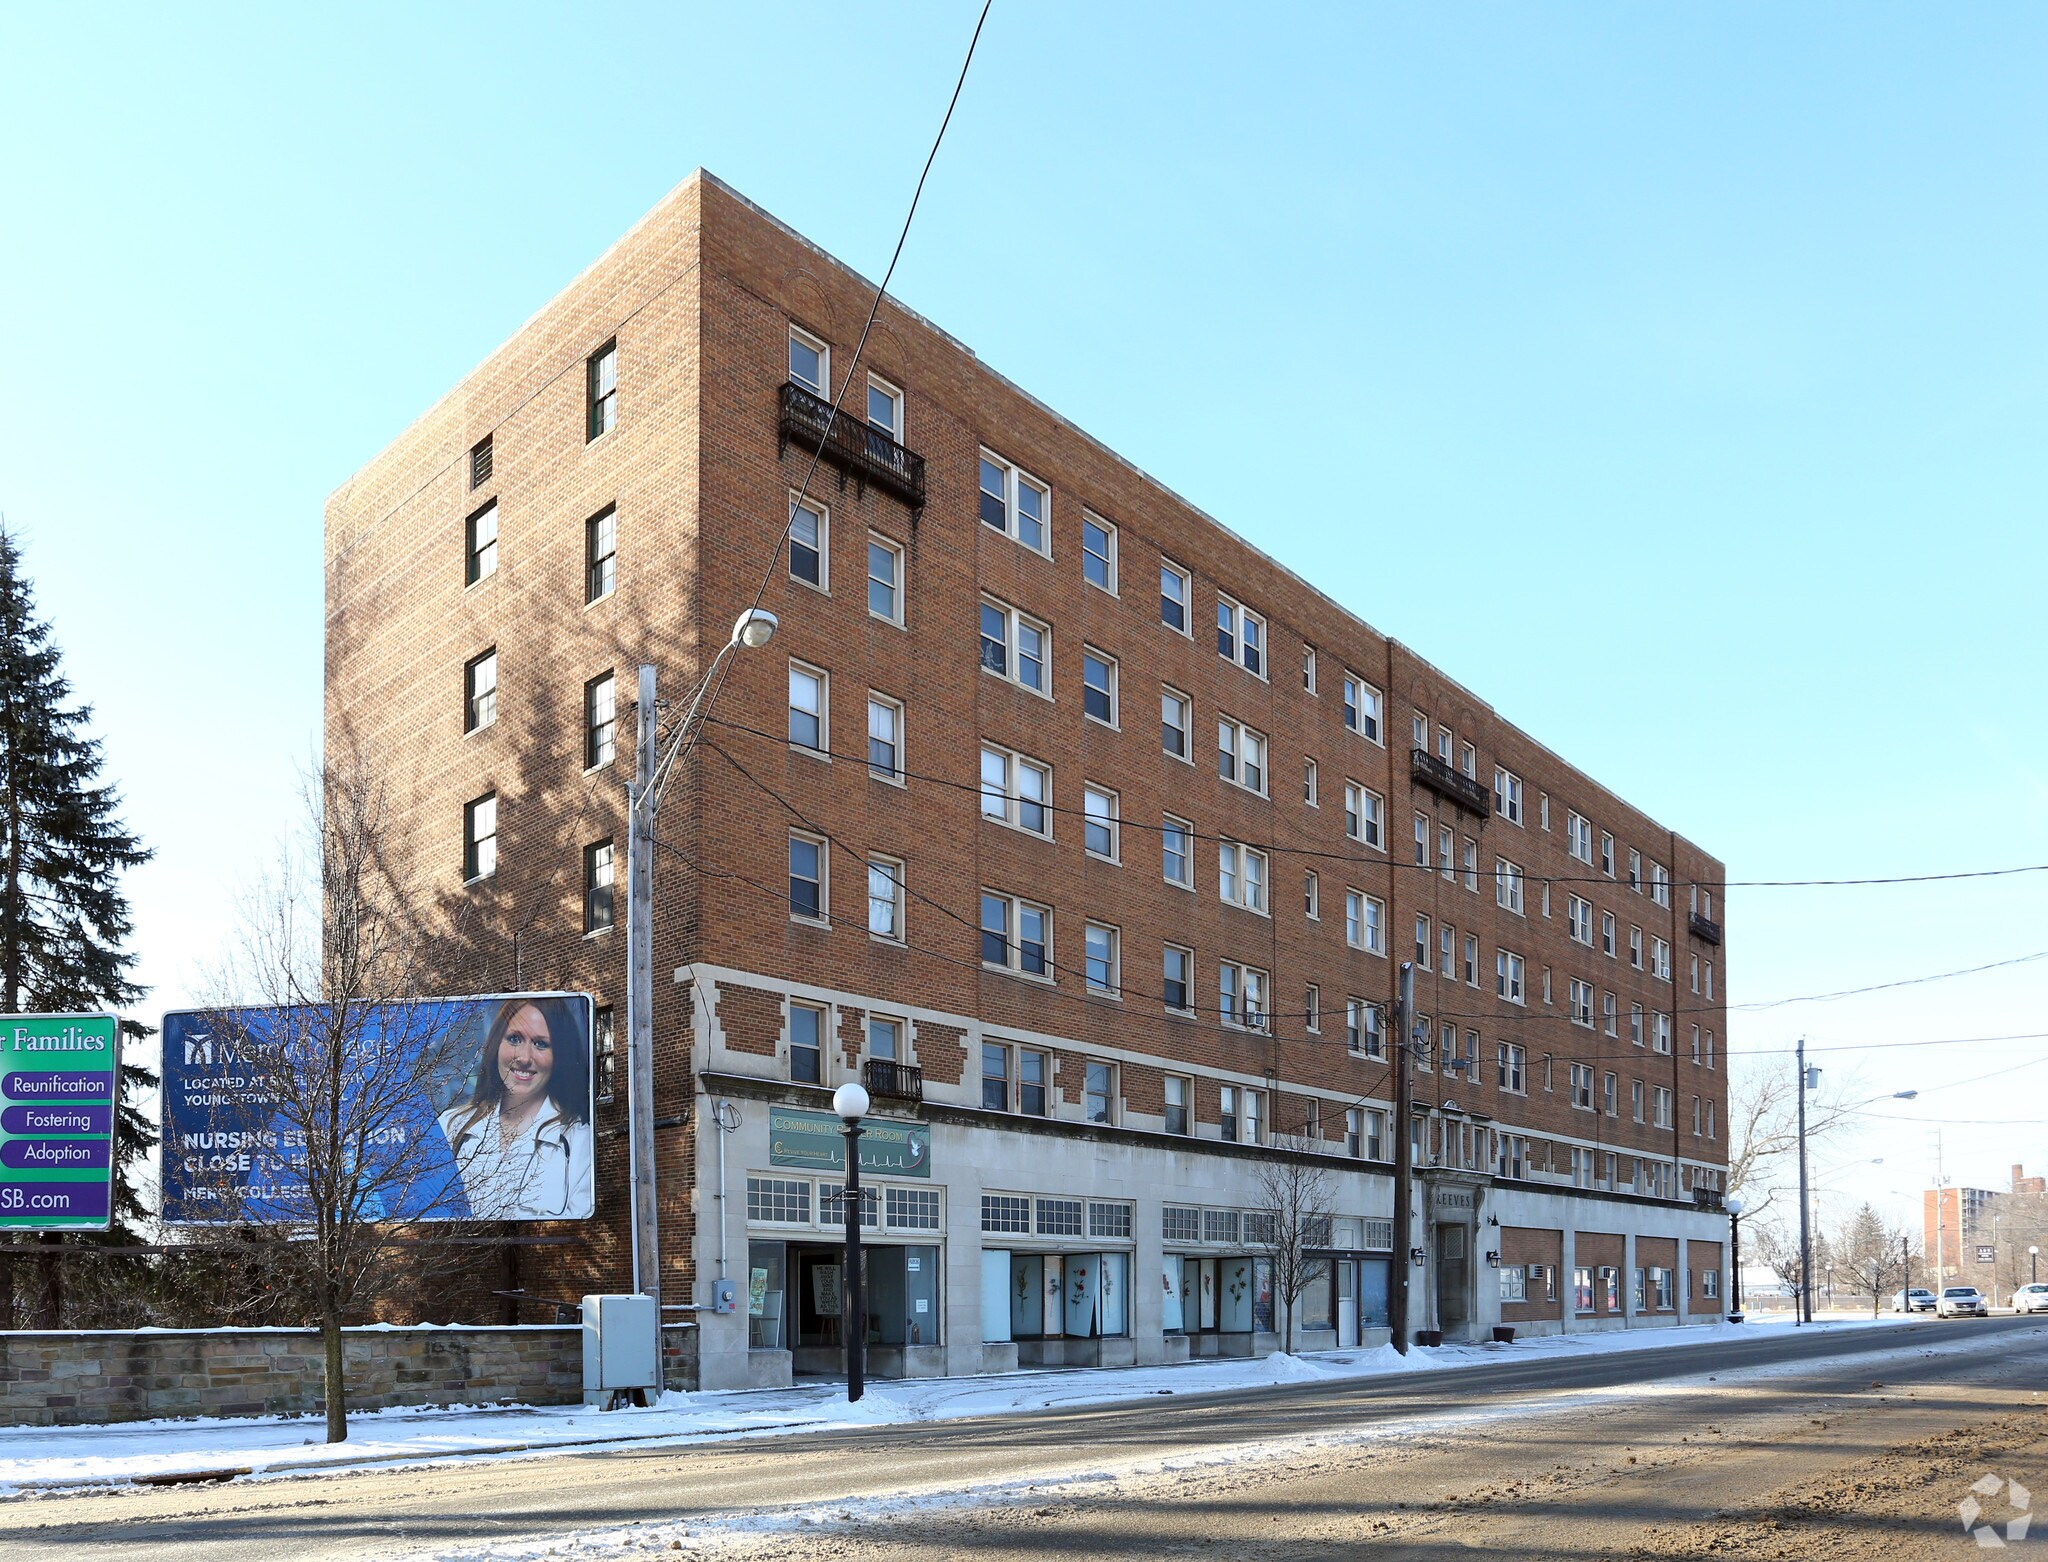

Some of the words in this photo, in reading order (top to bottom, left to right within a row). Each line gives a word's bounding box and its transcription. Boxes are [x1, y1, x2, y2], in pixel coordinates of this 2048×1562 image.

[13, 1026, 105, 1051] Families
[14, 1074, 105, 1093] Reunification
[184, 1076, 245, 1090] LOCATED
[248, 1075, 266, 1089] AT
[184, 1092, 281, 1107] YOUNGTOWN
[26, 1111, 91, 1131] Fostering
[184, 1131, 278, 1150] NURSING
[875, 1127, 904, 1142] ROOM
[24, 1142, 91, 1165] Adoption
[184, 1153, 251, 1173] CLOSE
[257, 1151, 285, 1171] TO
